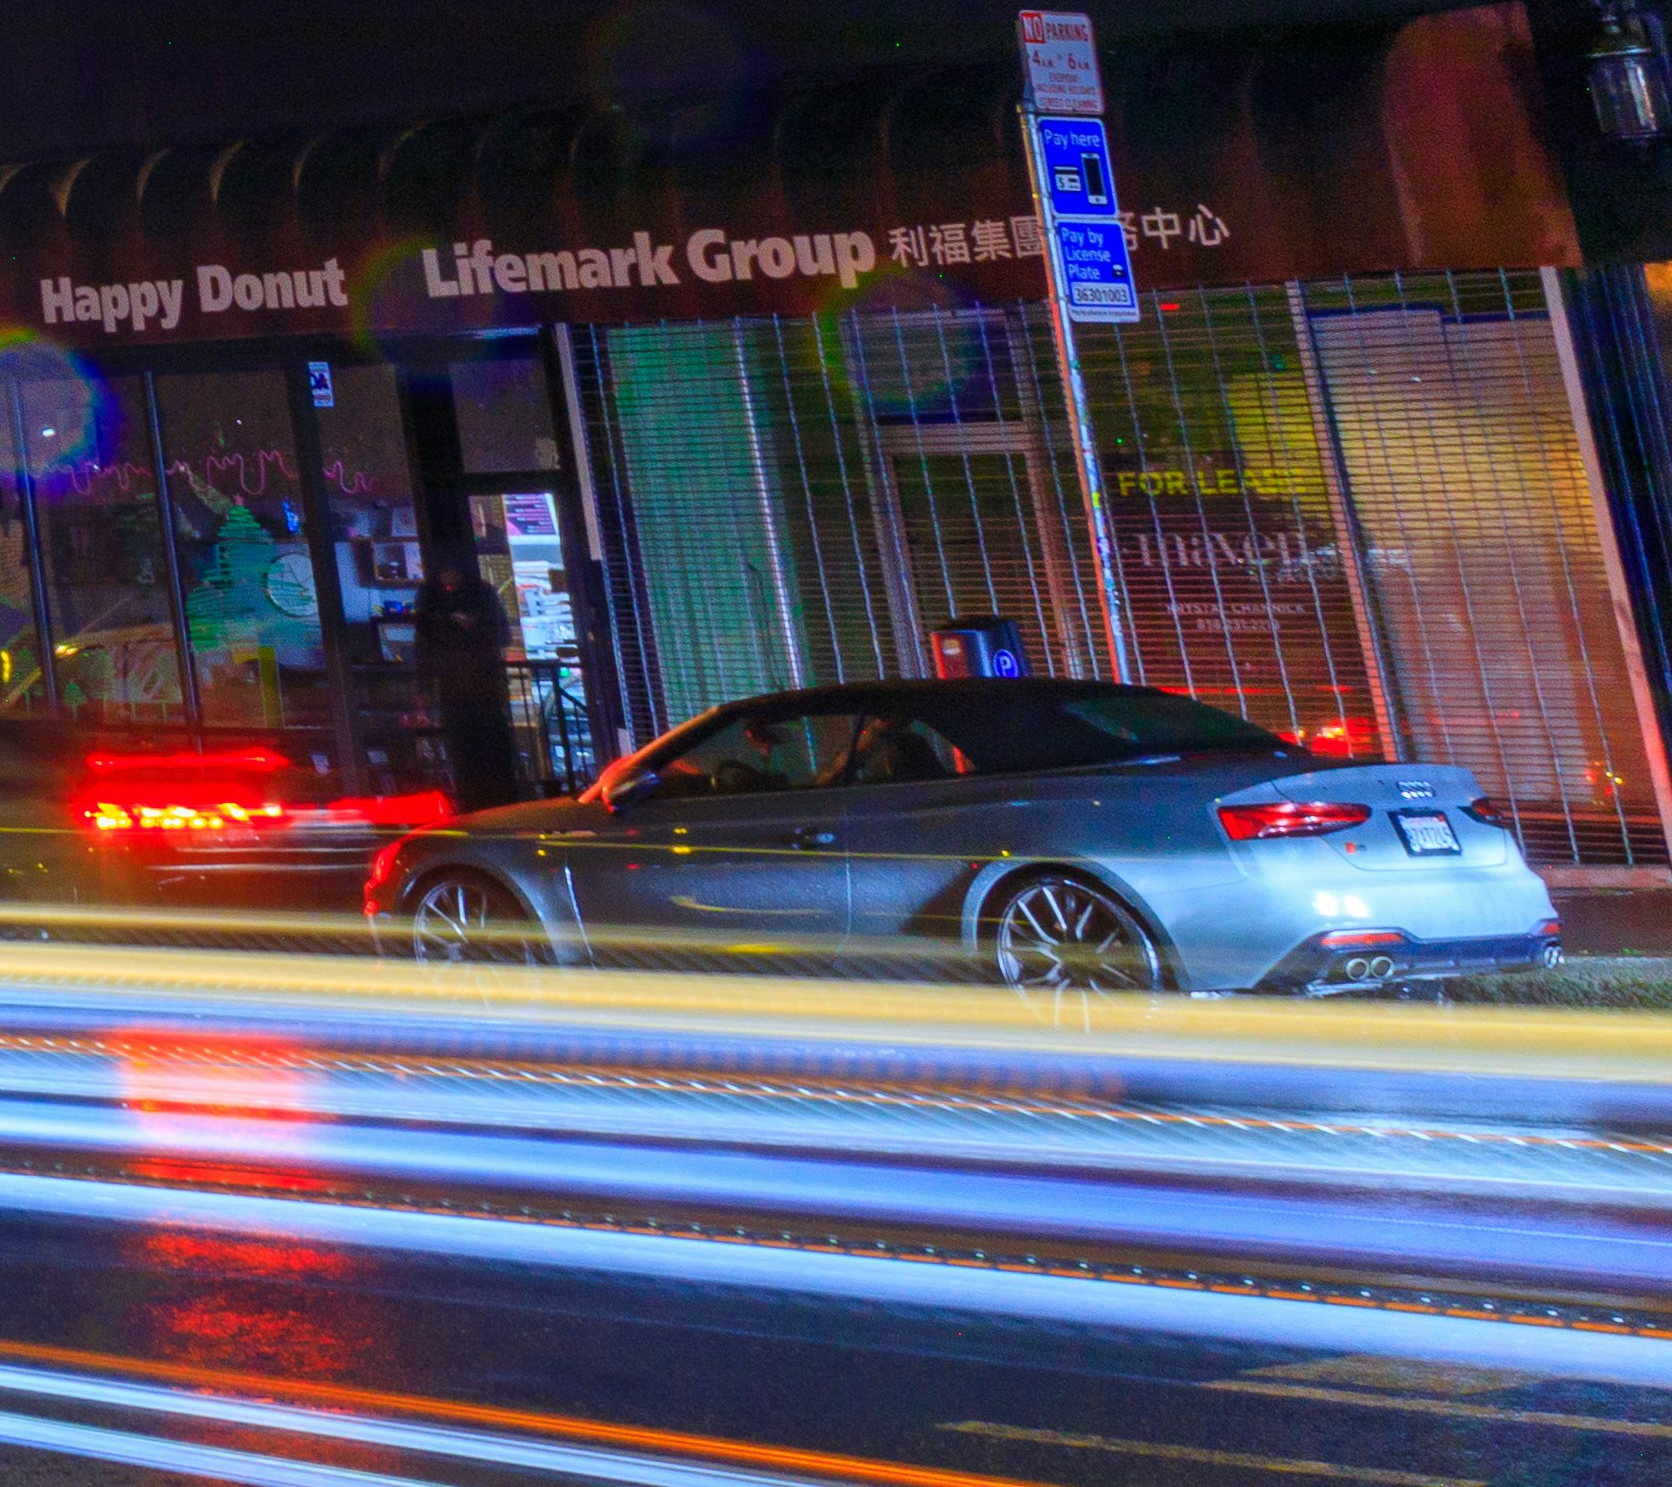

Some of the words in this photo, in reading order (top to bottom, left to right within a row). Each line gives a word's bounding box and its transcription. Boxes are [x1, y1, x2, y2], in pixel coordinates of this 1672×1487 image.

[1043, 128, 1069, 150] Pay
[1070, 129, 1101, 148] here
[1061, 227, 1084, 247] Pay
[1086, 227, 1105, 247] by
[422, 230, 680, 298] Lifemark
[686, 228, 876, 289] Group
[1064, 245, 1112, 263] License
[1067, 263, 1101, 281] Plate
[40, 277, 184, 333] Happy
[196, 257, 349, 313] Donut
[1118, 470, 1189, 497] FOR
